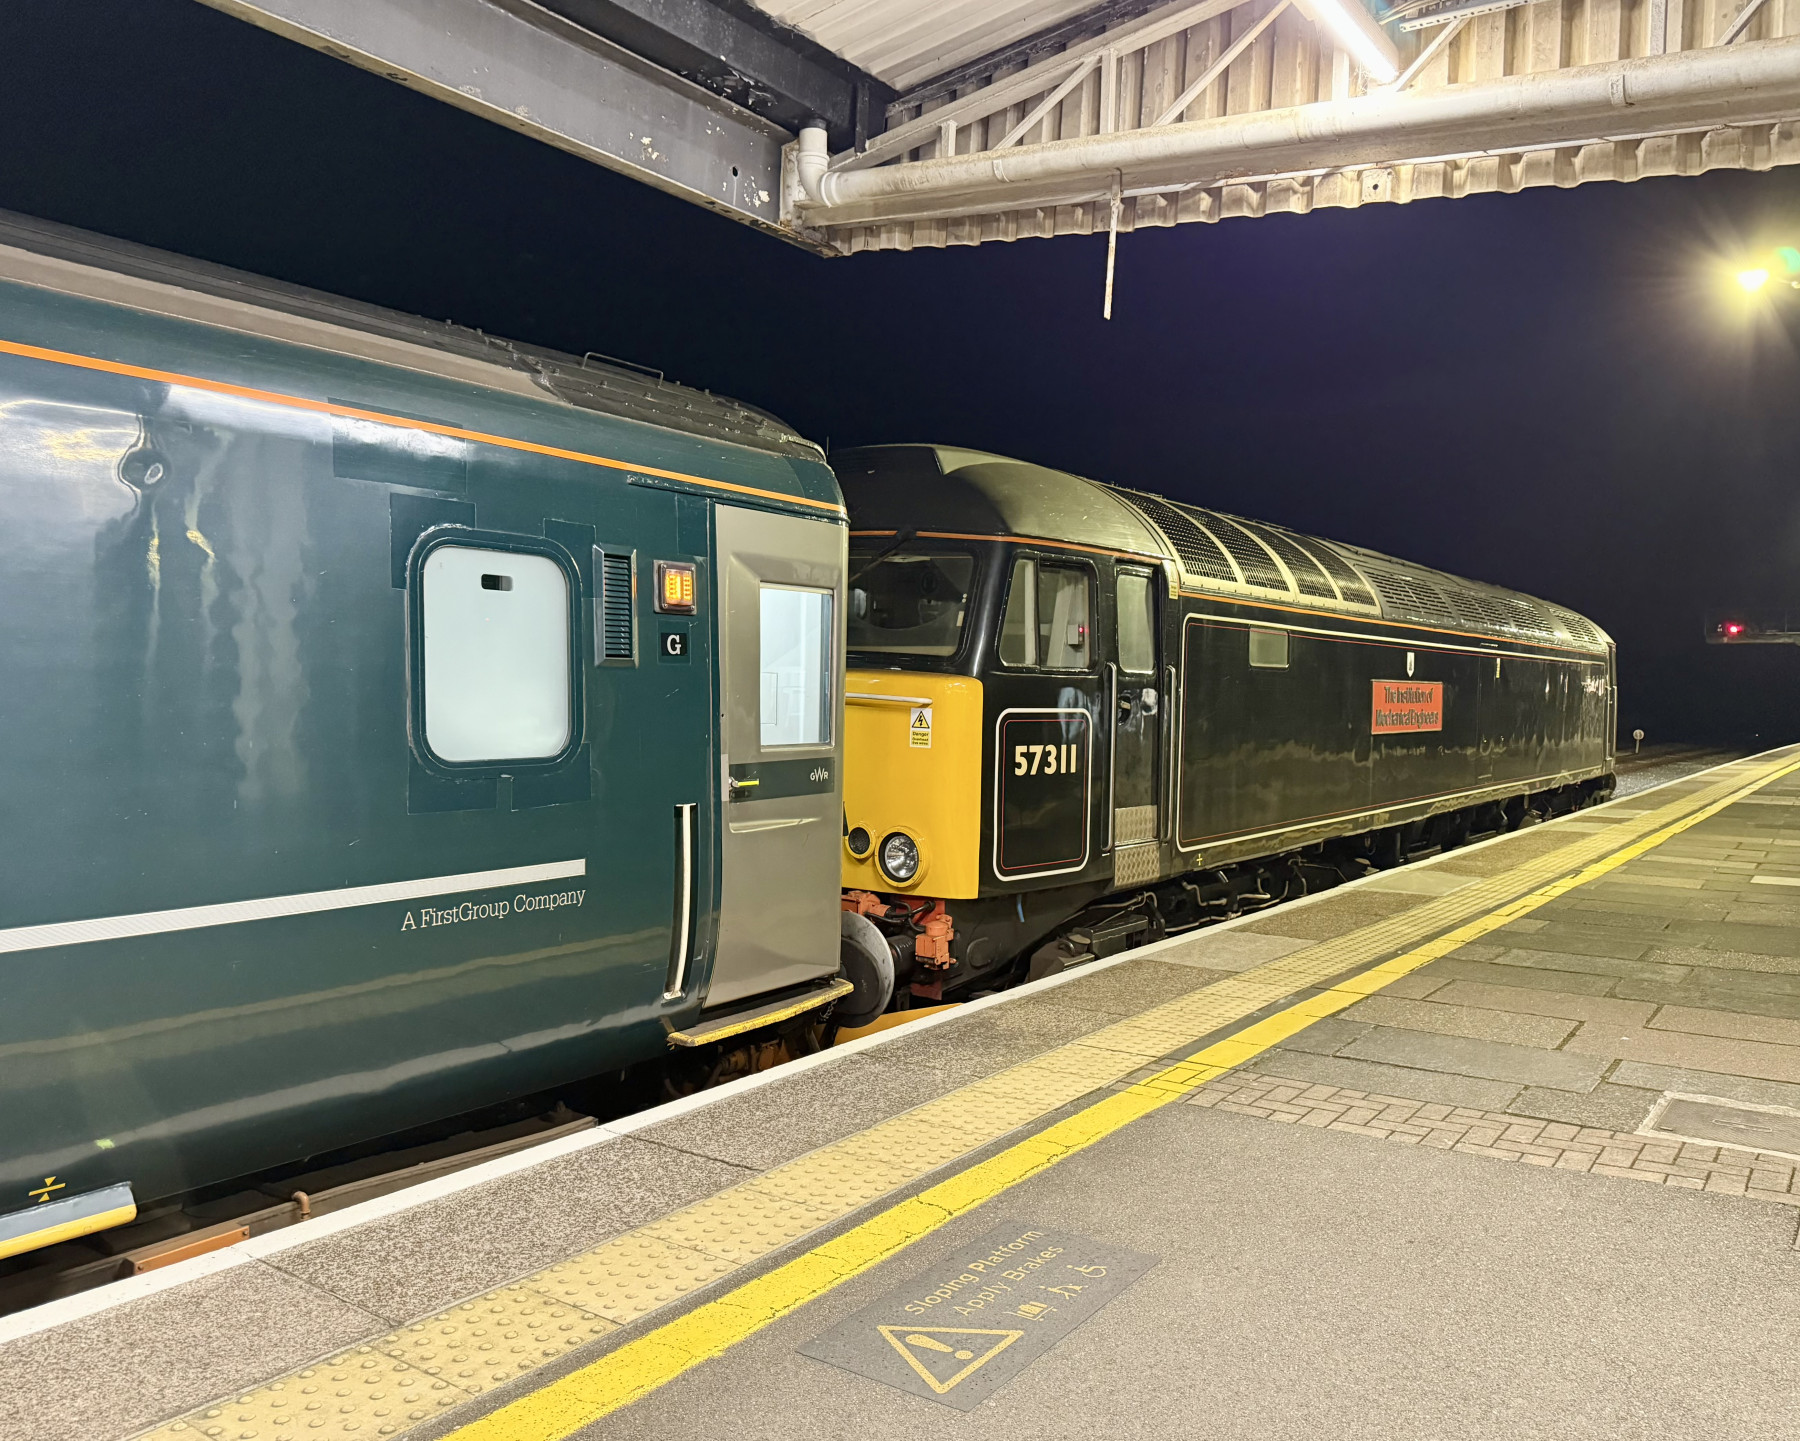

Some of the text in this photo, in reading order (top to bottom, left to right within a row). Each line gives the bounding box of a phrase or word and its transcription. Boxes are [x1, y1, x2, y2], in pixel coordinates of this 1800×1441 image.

[666, 634, 682, 655] G
[810, 766, 829, 782] GWR
[1014, 744, 1077, 776] 57311
[400, 889, 587, 931] A FirstGroup Company
[904, 1230, 1044, 1315] Sloping Platform
[953, 1246, 1064, 1316] Apply Brakes
